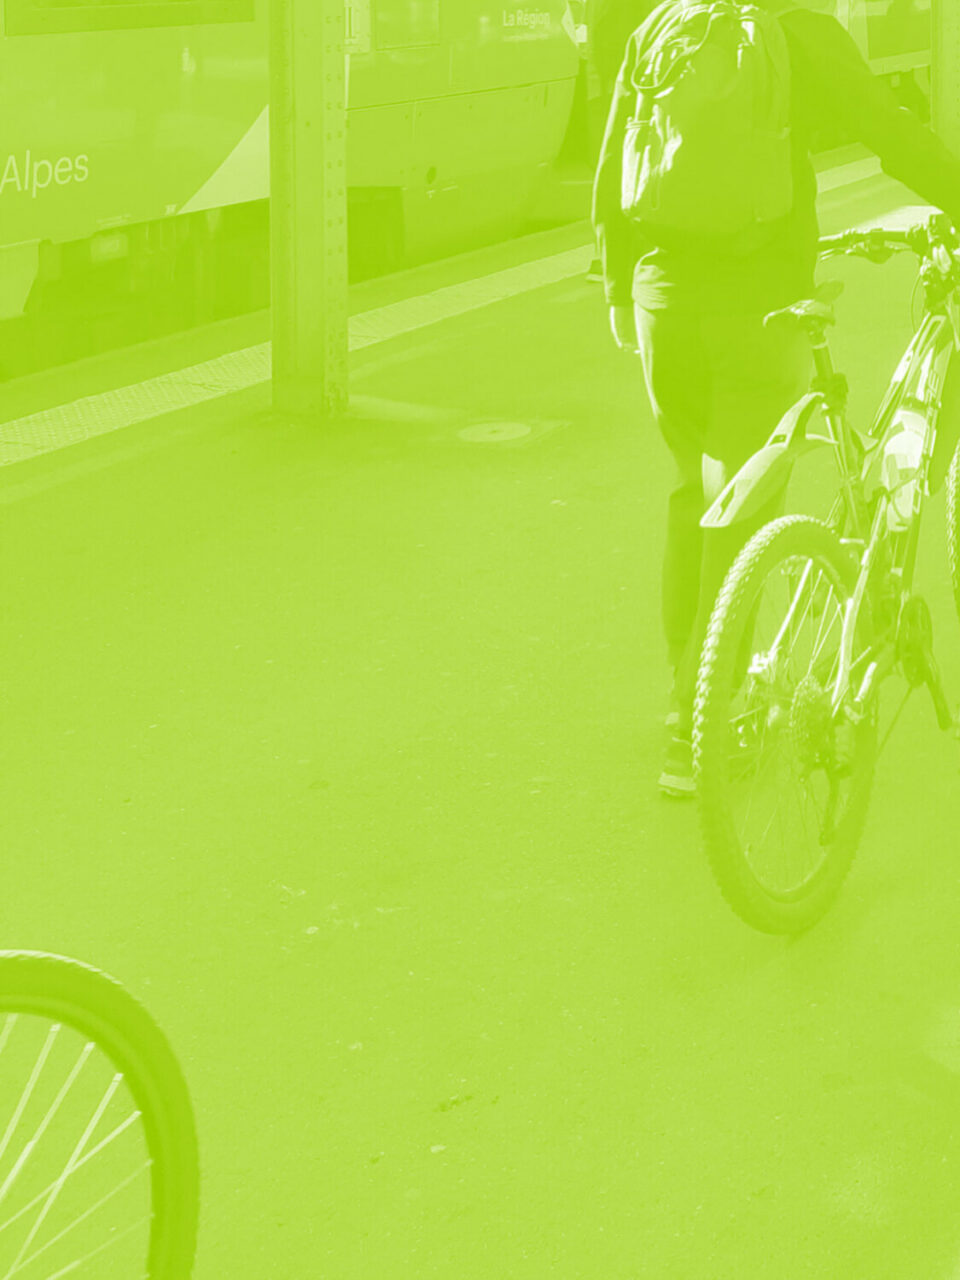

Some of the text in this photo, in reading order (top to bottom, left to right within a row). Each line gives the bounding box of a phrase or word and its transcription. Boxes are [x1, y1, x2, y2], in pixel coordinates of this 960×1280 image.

[503, 8, 551, 29] La Région
[0, 149, 89, 198] Alpes
